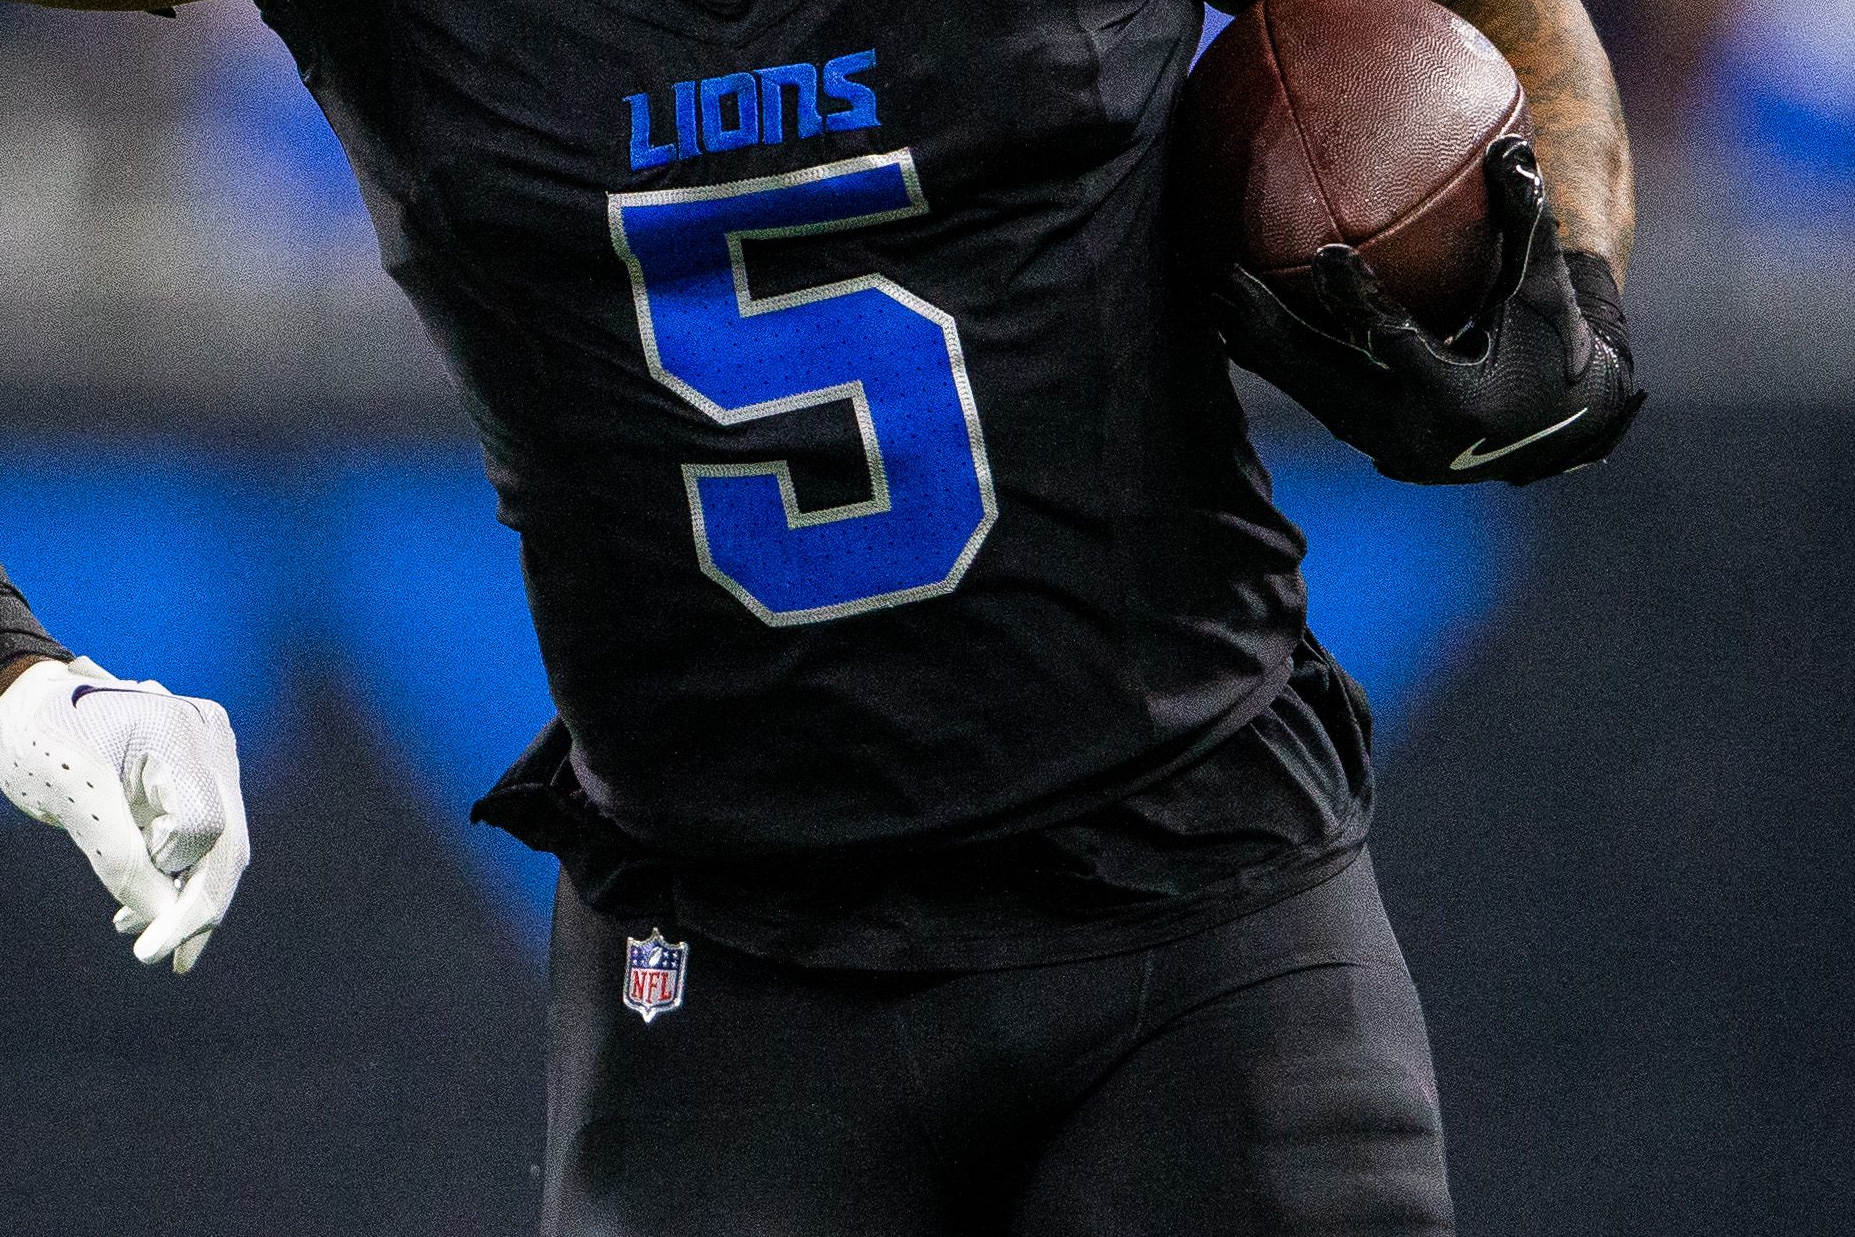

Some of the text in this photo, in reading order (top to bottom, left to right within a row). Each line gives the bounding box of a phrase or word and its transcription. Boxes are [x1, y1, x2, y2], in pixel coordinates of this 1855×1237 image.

[623, 47, 882, 172] LIONS
[607, 147, 999, 627] 5
[631, 970, 672, 1004] NFL
